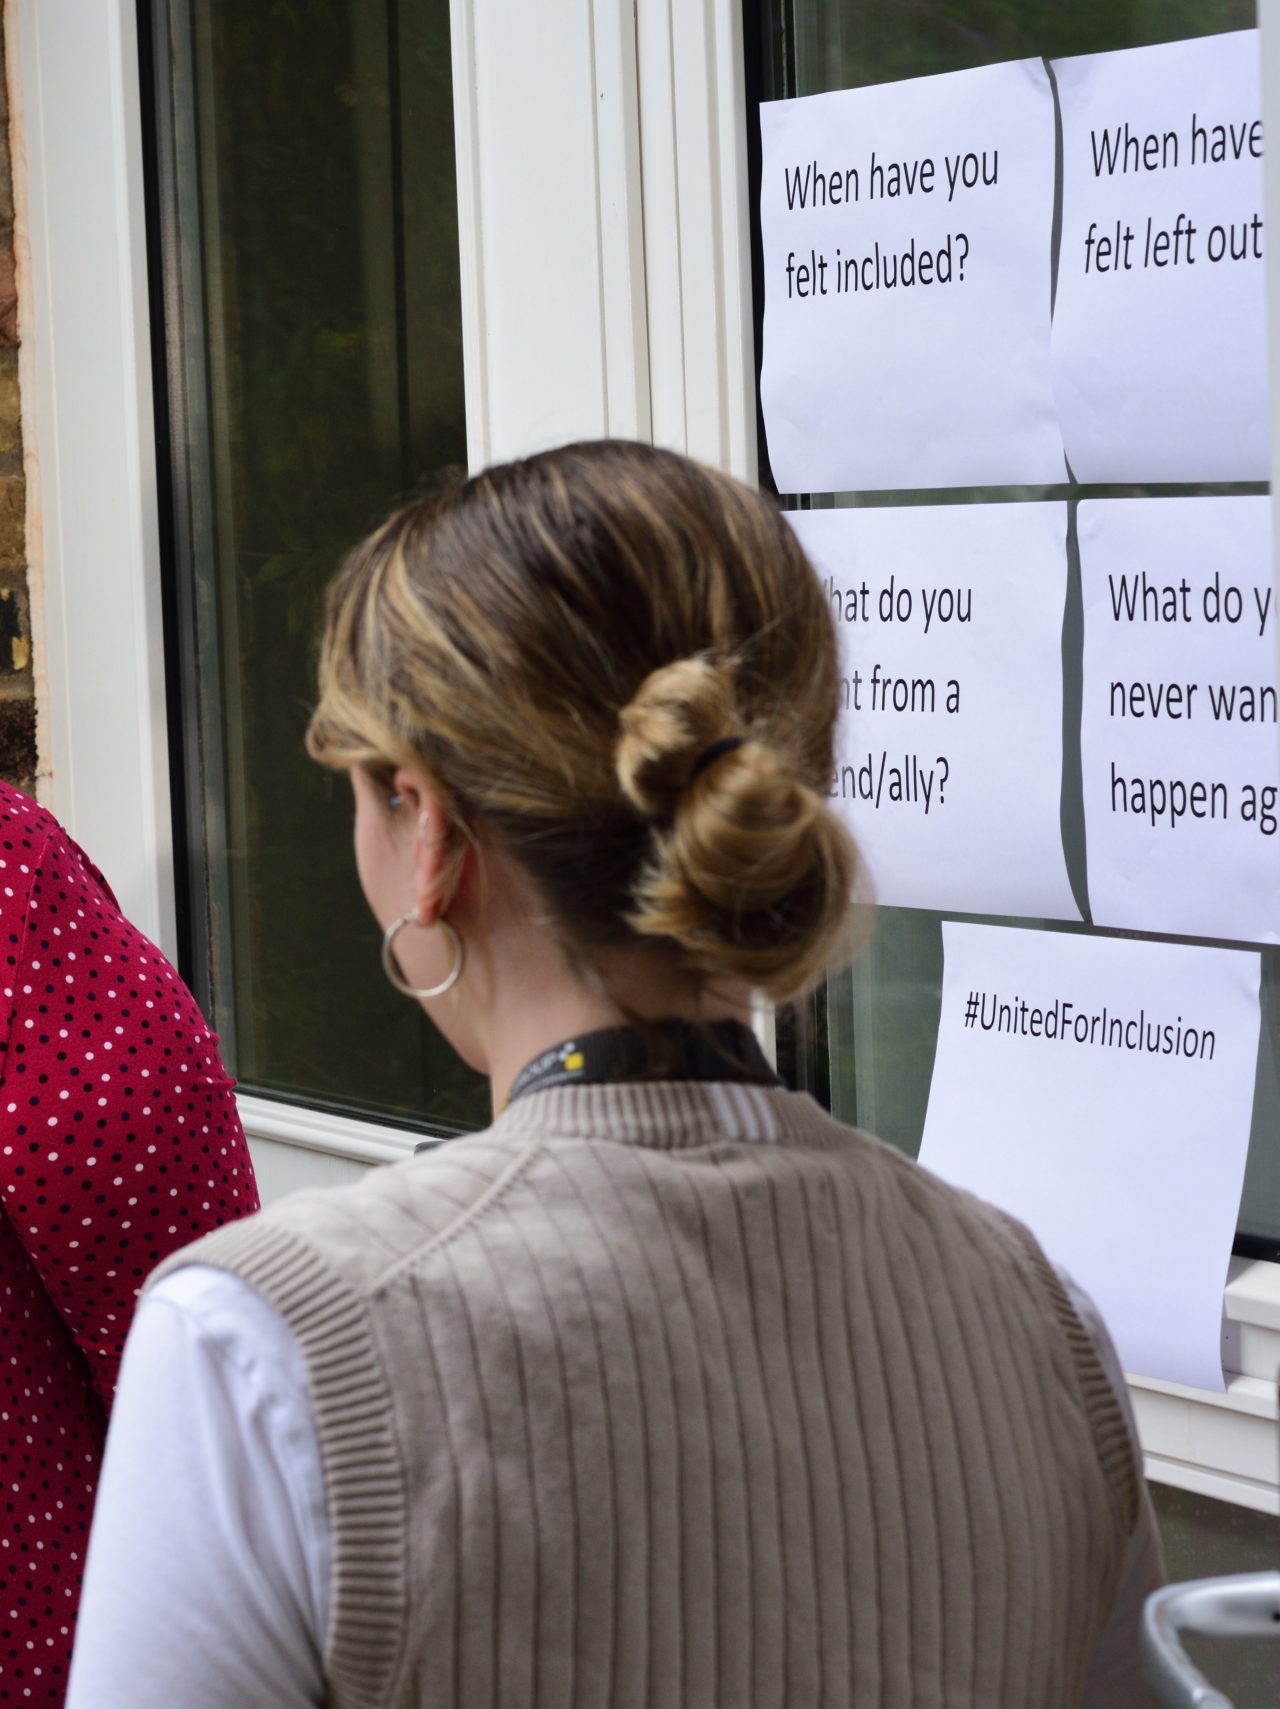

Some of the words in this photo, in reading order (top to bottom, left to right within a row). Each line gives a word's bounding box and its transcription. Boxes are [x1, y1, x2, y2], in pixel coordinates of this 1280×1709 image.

[1090, 122, 1179, 178] When
[1191, 112, 1263, 166] have
[784, 160, 859, 211] When
[869, 151, 935, 200] have
[944, 149, 999, 202] you
[785, 250, 828, 299] felt
[836, 233, 970, 294] included?
[1084, 221, 1135, 274] felt
[1143, 213, 1197, 268] left
[1207, 213, 1263, 263] out
[824, 575, 870, 623] hat
[878, 574, 913, 623] do
[921, 588, 972, 634] you
[1108, 570, 1192, 623] What
[1202, 571, 1243, 624] do
[1253, 587, 1272, 637] y
[839, 669, 862, 711] nt
[870, 663, 935, 713] from
[945, 679, 960, 714] a
[1110, 680, 1198, 720] never
[1207, 684, 1278, 723] wan
[828, 750, 949, 815] end/ally?
[1110, 761, 1228, 829] happen
[1240, 784, 1279, 836] ag
[964, 991, 1216, 1061] #UnitedForInclusion
